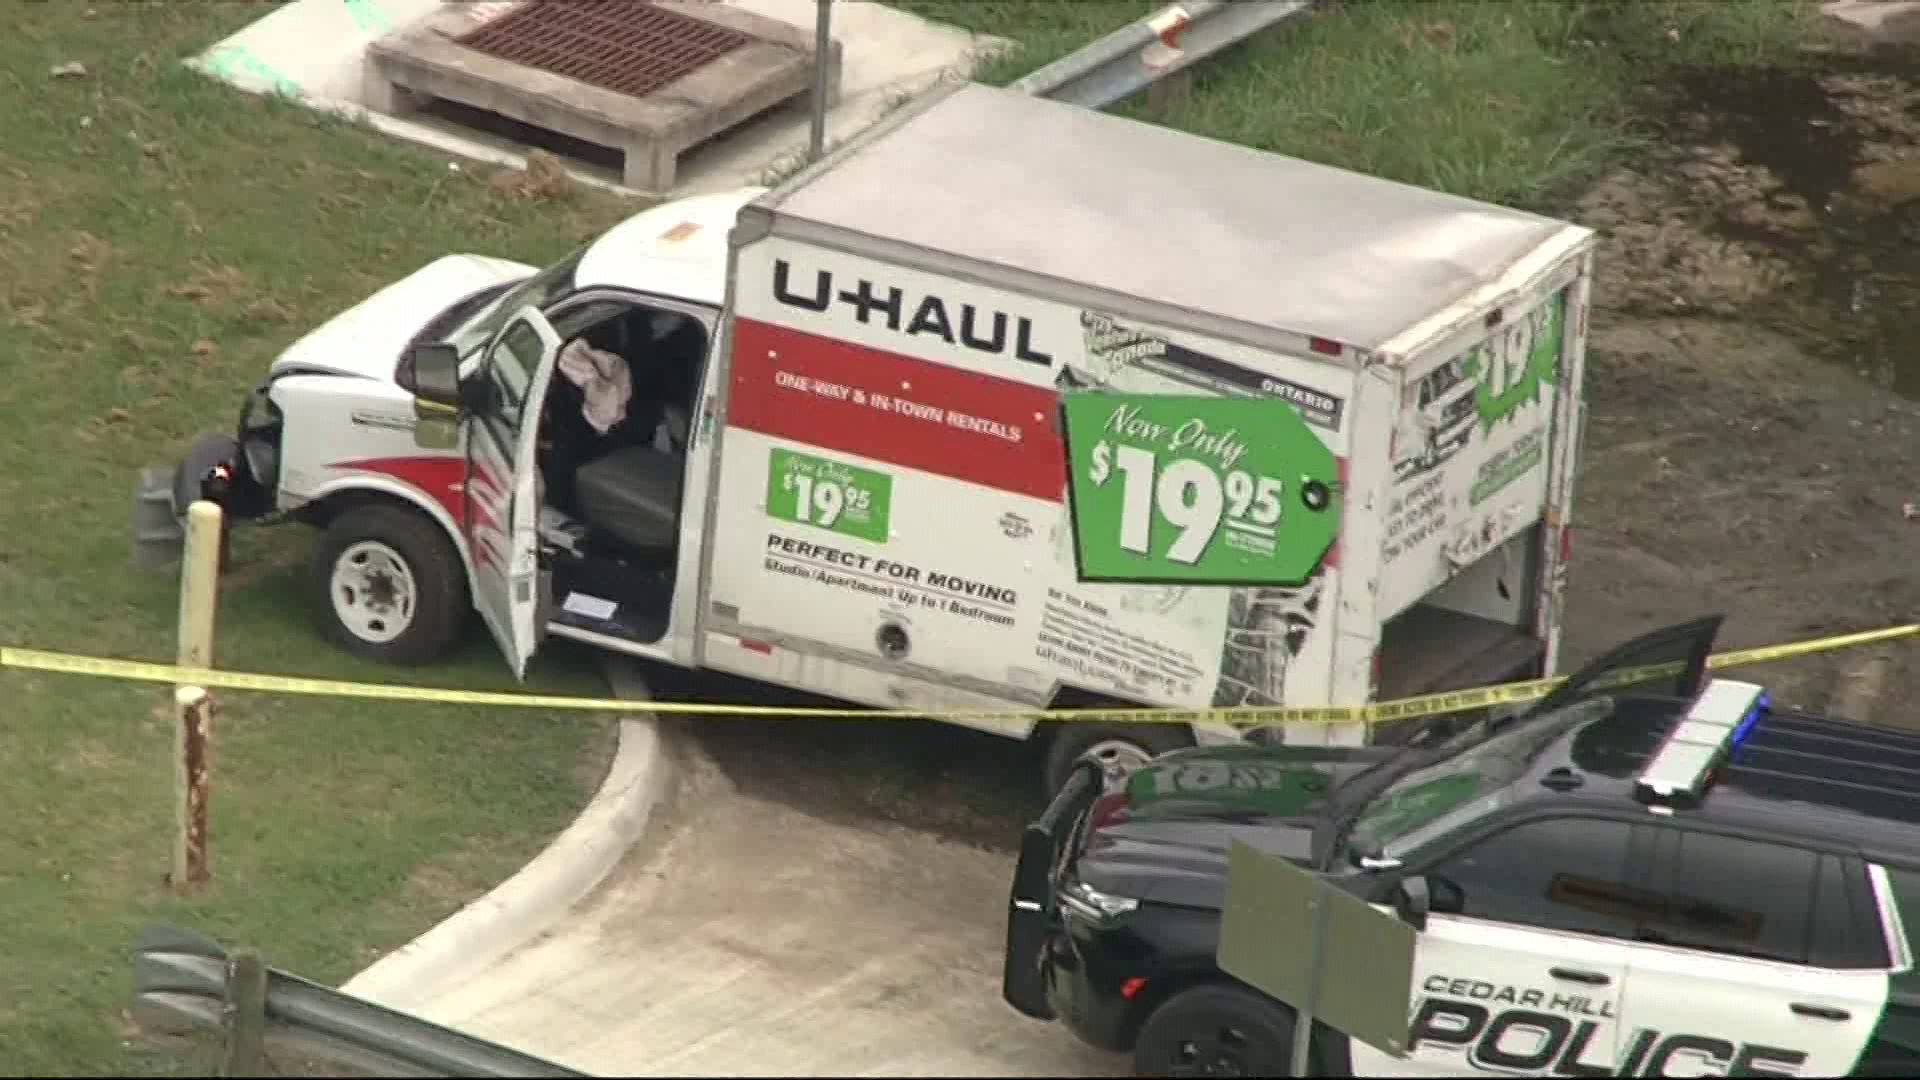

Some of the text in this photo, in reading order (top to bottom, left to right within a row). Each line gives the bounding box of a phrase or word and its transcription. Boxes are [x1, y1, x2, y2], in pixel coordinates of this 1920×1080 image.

[773, 259, 1052, 367] U-HAUL
[775, 371, 1023, 442] ONE-WAY & IN-TOWN RENTALS
[1261, 379, 1335, 411] ONTARIO
[1104, 404, 1248, 469] Now Only
[767, 533, 873, 570] PERFECT
[874, 559, 920, 583] FOR
[927, 570, 1017, 605] MOVING
[899, 590, 917, 606] Up
[950, 599, 1016, 627] Bedroom
[1423, 974, 1616, 1019] CEDAR HILL
[1409, 998, 1809, 1077] POLICE
